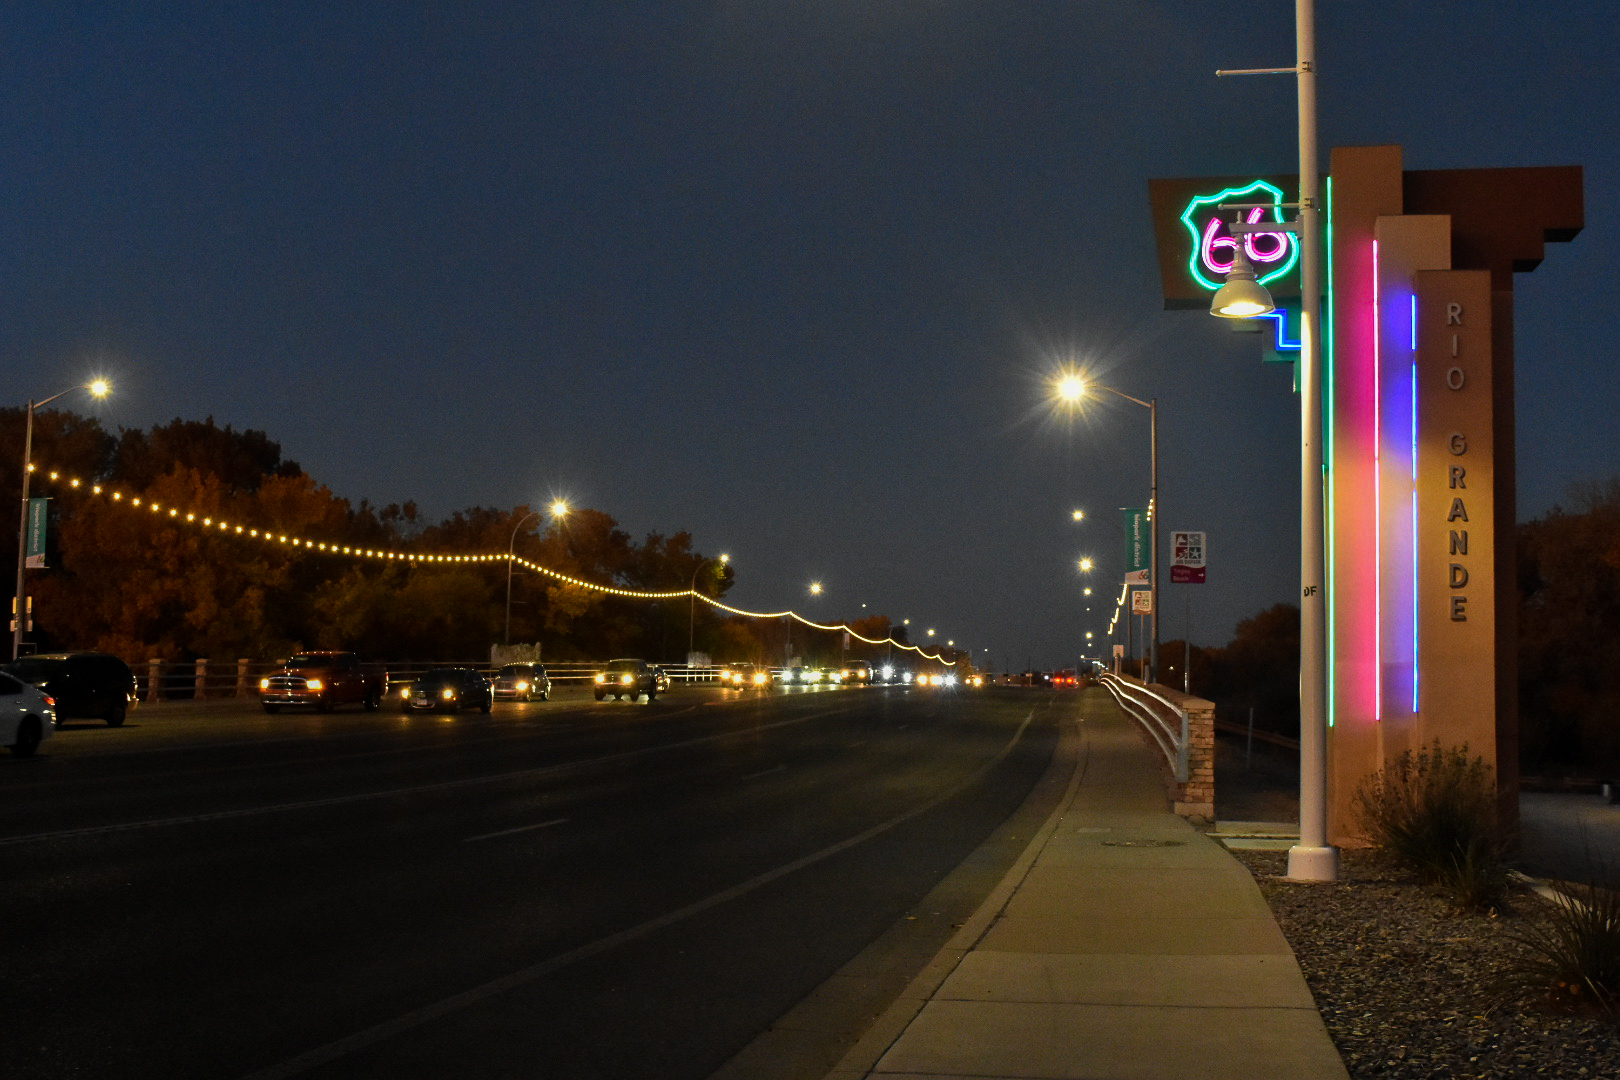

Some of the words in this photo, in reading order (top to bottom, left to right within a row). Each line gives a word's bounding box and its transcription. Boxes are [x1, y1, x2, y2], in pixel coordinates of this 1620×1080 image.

[1201, 207, 1289, 274] 66
[1445, 302, 1465, 391] RIO
[1447, 432, 1469, 622] GRANDE
